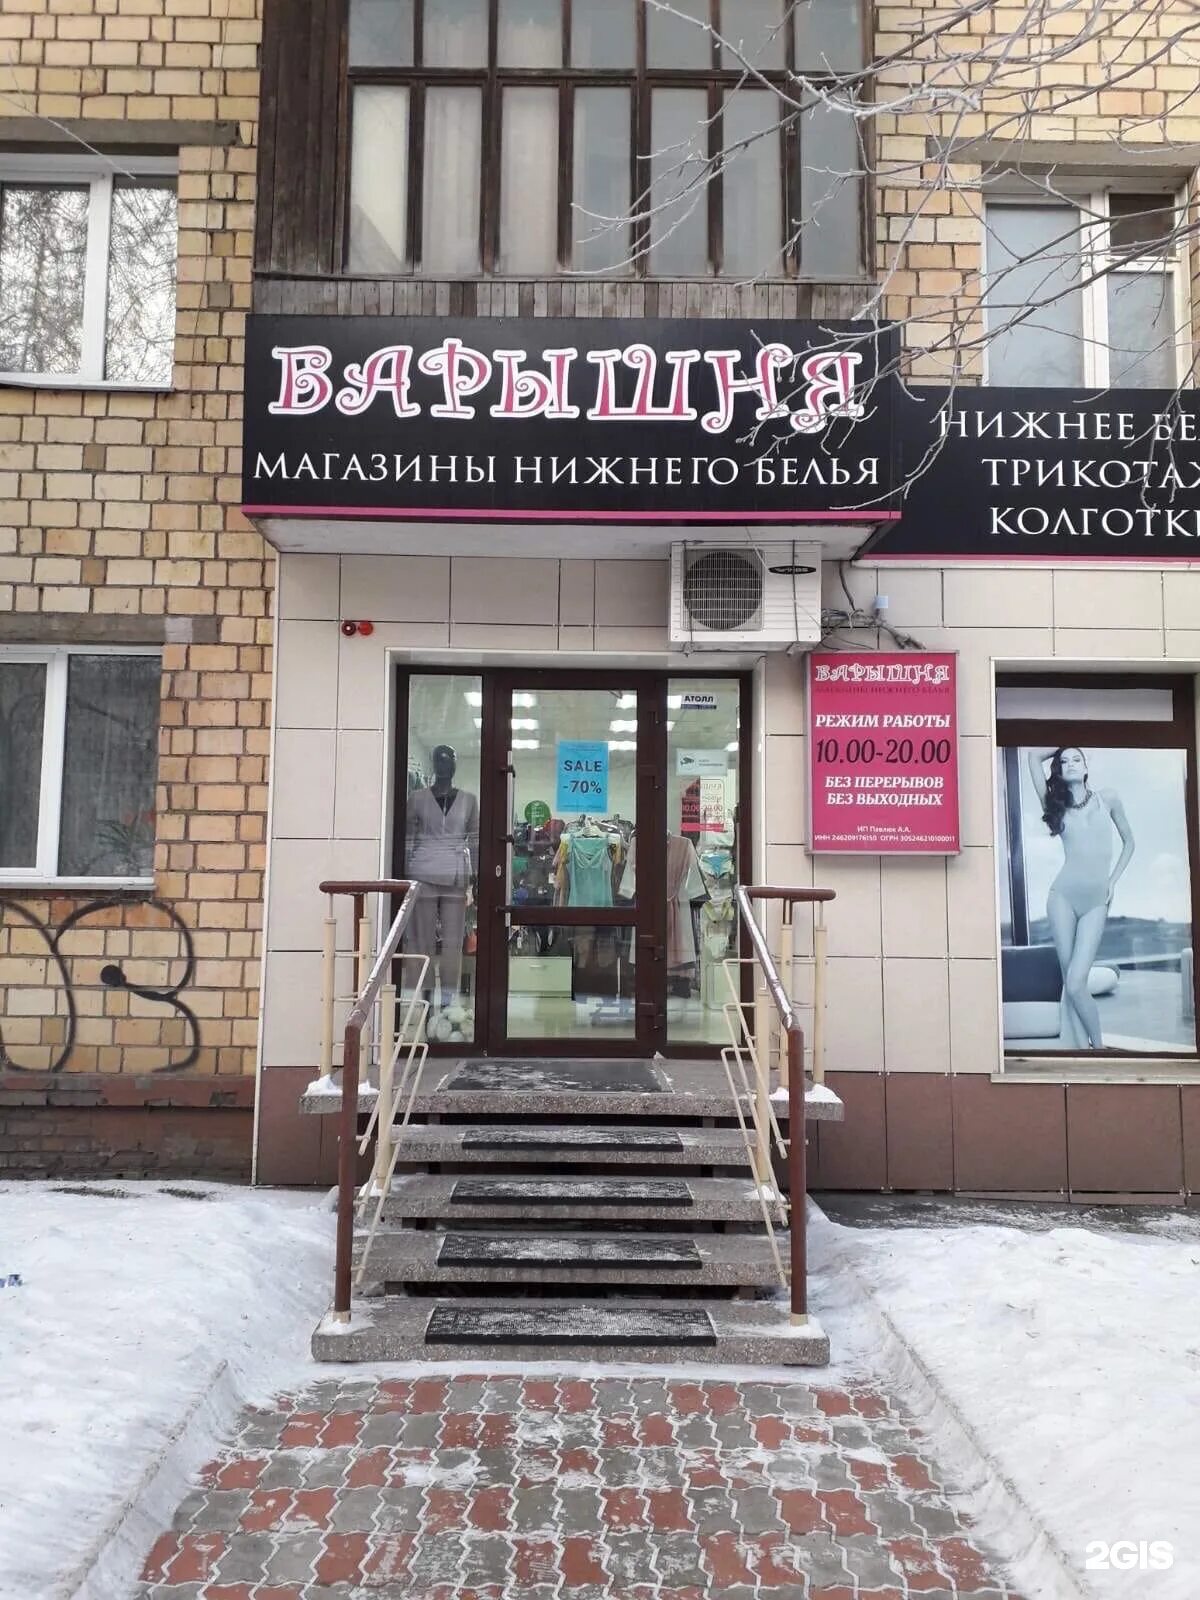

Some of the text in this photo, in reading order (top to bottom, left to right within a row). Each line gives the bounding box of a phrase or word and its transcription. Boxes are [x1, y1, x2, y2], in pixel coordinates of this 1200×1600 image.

[939, 410, 1200, 441] НИЖНЕЕ БЕ
[253, 451, 880, 486] МАГАЗИНЫ НИЖНЕГО БЕЛЬЯ
[990, 507, 1200, 537] КОЛГОТК
[684, 695, 714, 703] АТОЛЛ
[815, 714, 951, 728] РЕЖИМ РАБОТЫ
[816, 738, 951, 764] 10.00-20.00
[563, 759, 602, 772] SALE
[563, 780, 602, 794] -70%
[825, 776, 944, 789] БЕЗ ПЕРЕРЫВОВ
[827, 793, 943, 807] БЕЗ ВЫХОДНЫХ
[857, 825, 868, 833] ИП
[880, 834, 898, 842] ОГРН
